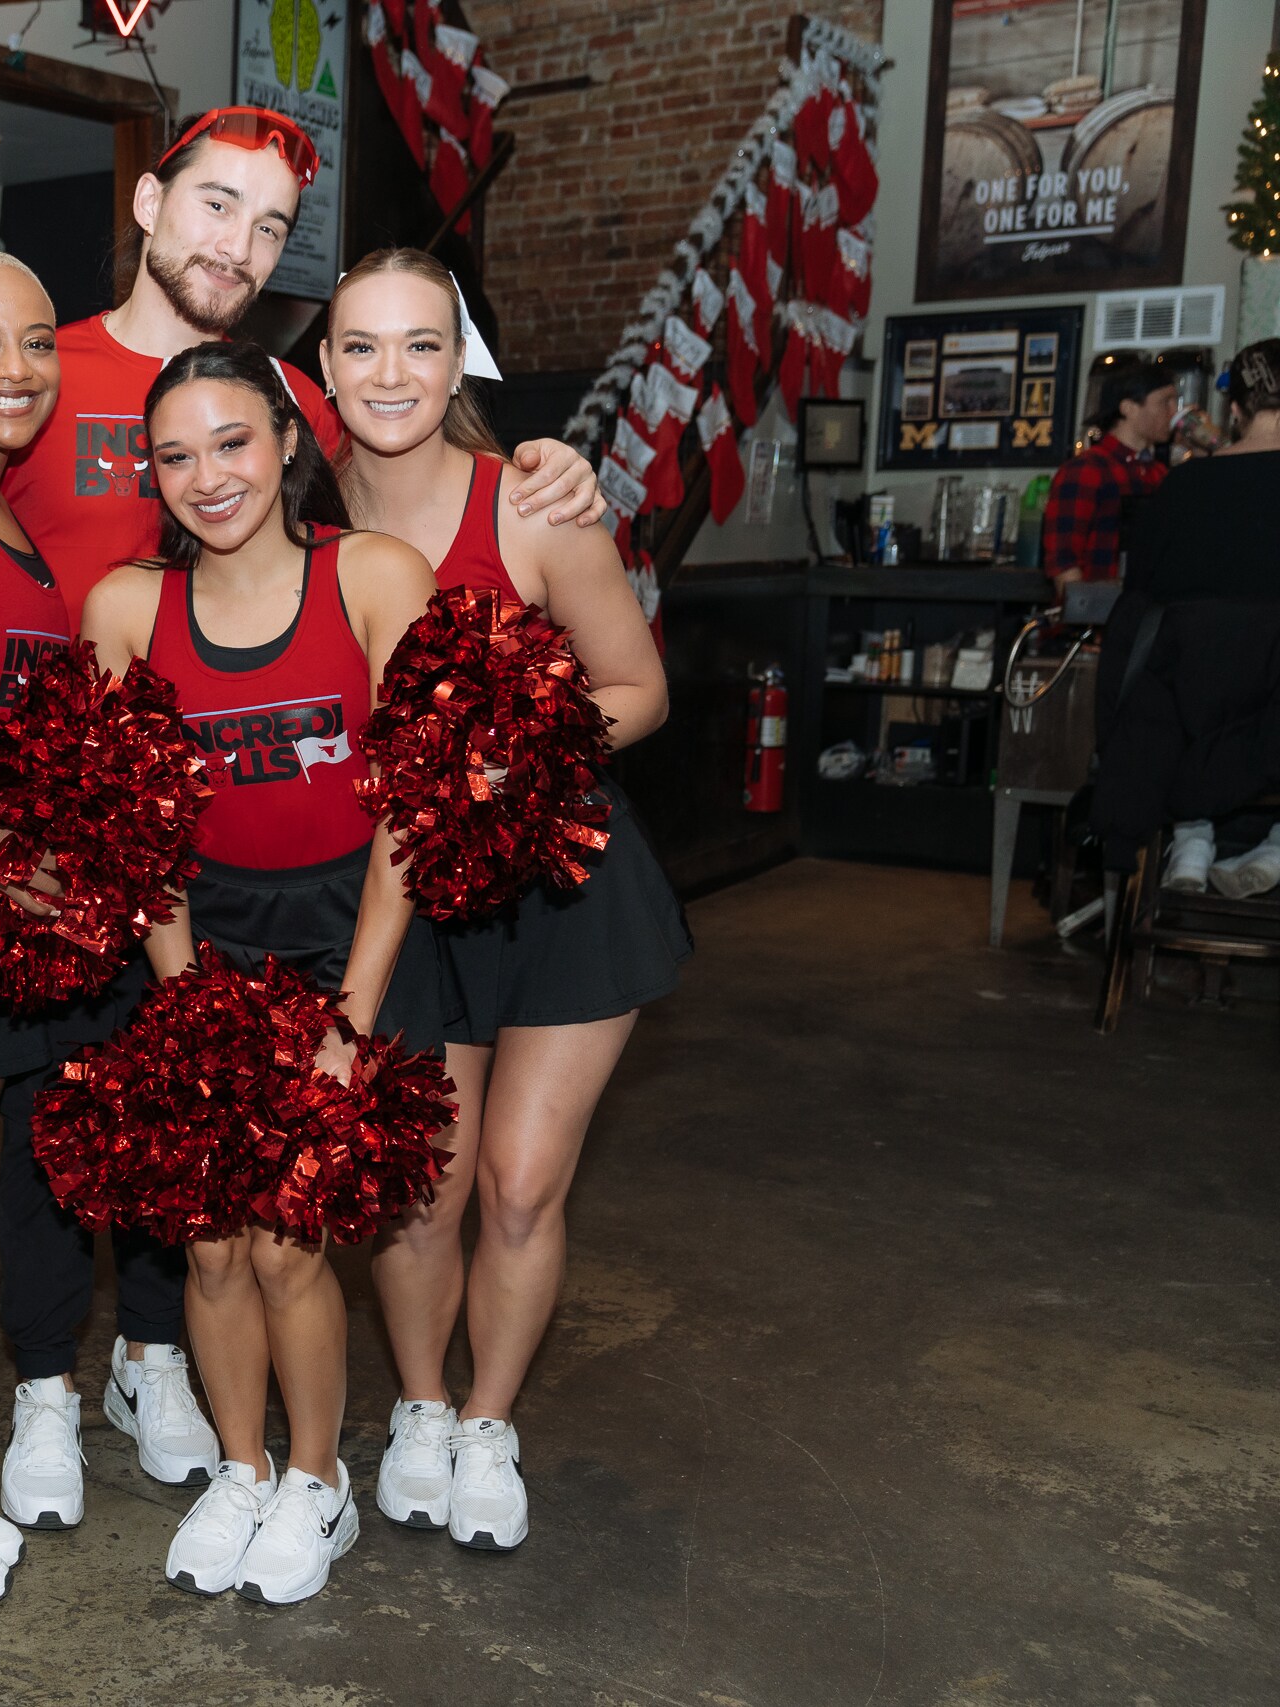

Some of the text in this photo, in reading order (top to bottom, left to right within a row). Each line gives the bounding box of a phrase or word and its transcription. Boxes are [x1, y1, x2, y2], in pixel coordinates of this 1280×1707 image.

[975, 165, 1130, 204] ONE FOR YOU,
[984, 196, 1117, 233] ONE FOR ME
[900, 422, 937, 450] M
[1012, 420, 1053, 448] M
[179, 703, 343, 754] NCREDI
